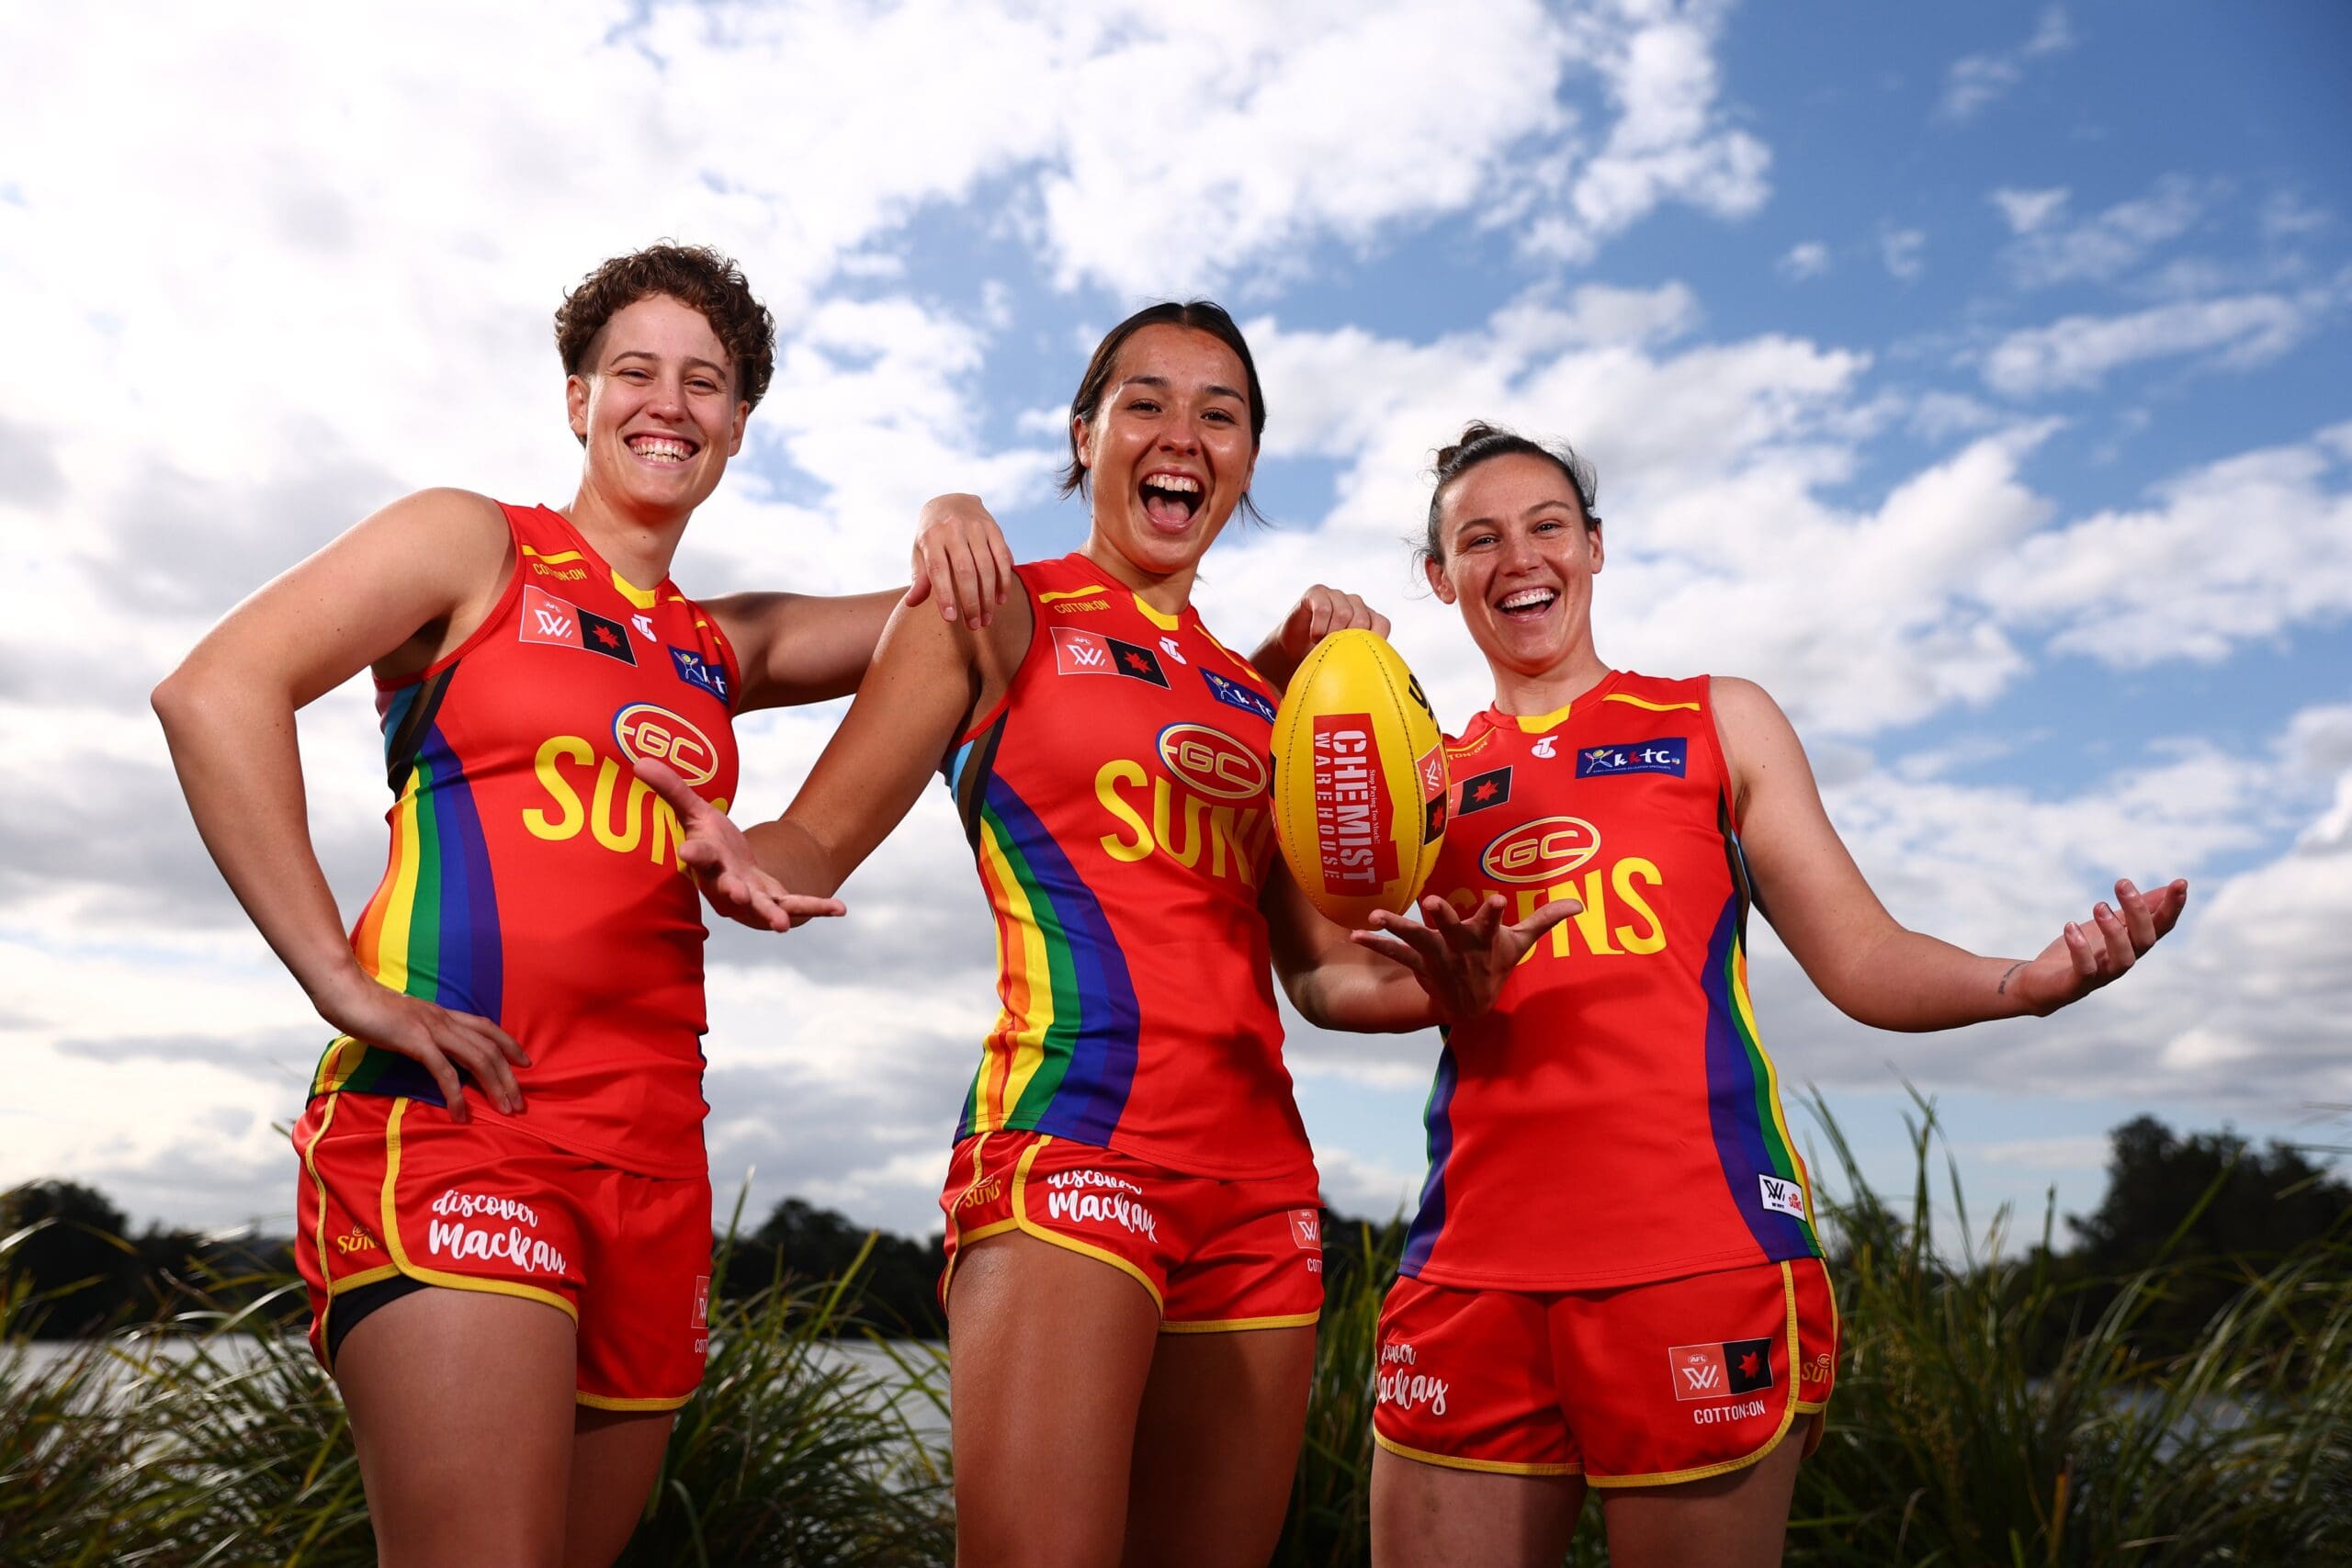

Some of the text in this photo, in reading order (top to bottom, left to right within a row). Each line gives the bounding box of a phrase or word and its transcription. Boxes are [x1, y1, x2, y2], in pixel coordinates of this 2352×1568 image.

[636, 721, 707, 774] GC
[1180, 740, 1255, 787] GC
[522, 736, 729, 888] SUN
[1315, 732, 1340, 879] WAREHOUSE
[1332, 729, 1376, 885] CHEMIST
[1502, 829, 1591, 869] GC
[432, 1190, 538, 1228] discover
[337, 1235, 378, 1255] SUN
[1693, 1399, 1766, 1425] COTTON:ON
